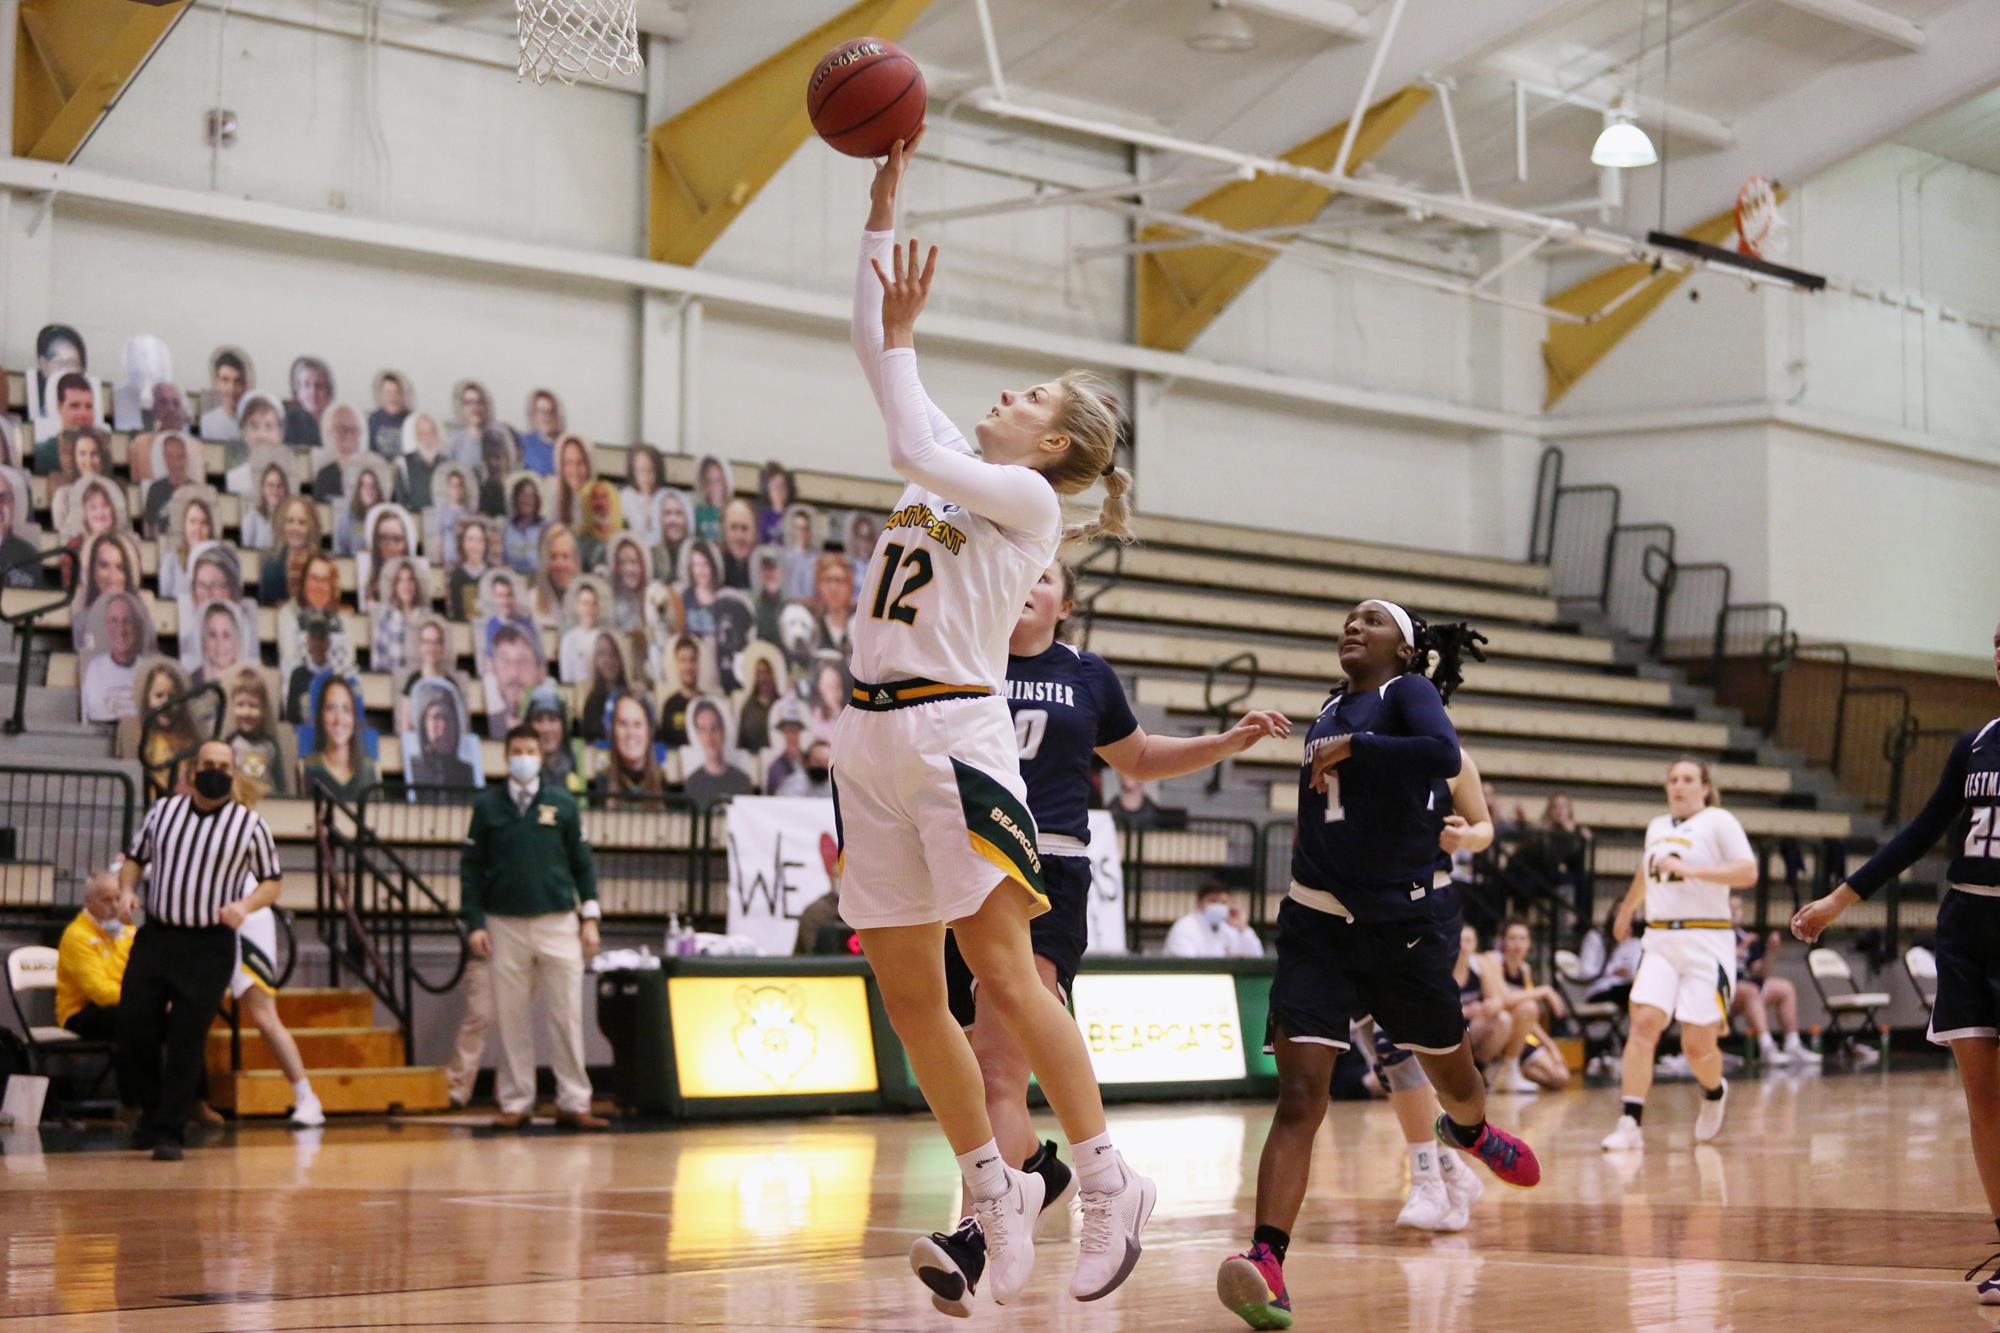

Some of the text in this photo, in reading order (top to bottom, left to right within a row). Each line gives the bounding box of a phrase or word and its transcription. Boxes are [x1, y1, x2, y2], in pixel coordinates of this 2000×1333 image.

[872, 542, 934, 626] 12
[1324, 769, 1346, 824] 1
[990, 806, 1041, 874] BEARCATS
[729, 831, 805, 919] WE
[1089, 1023, 1236, 1053] BEARCATS
